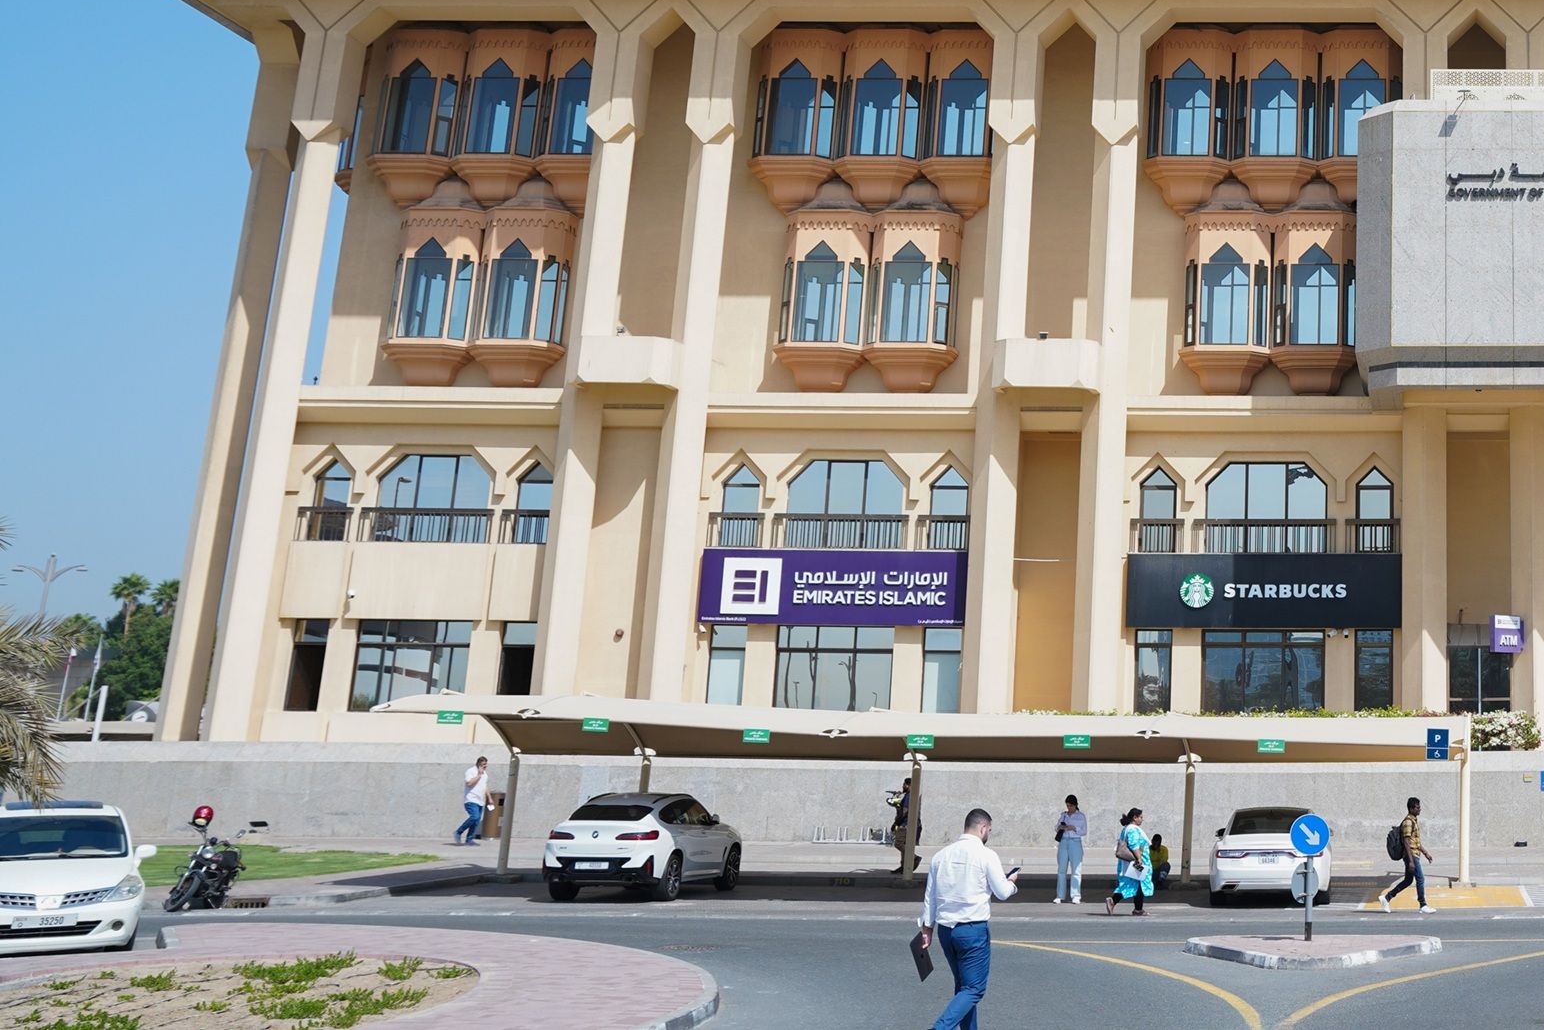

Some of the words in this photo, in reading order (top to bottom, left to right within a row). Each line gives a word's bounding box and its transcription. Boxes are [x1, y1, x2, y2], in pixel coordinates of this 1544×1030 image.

[1447, 187, 1526, 200] GOVERNMENT
[1528, 187, 1544, 200] OF
[794, 571, 876, 589] الإسلامي
[883, 571, 949, 589] الإمارات
[792, 589, 877, 606] EMIRATES
[878, 590, 947, 606] ISLAMIC
[1223, 582, 1348, 600] STARBUCKS
[1500, 634, 1518, 646] ATM
[1434, 734, 1442, 743] P
[40, 916, 65, 926] 35250
